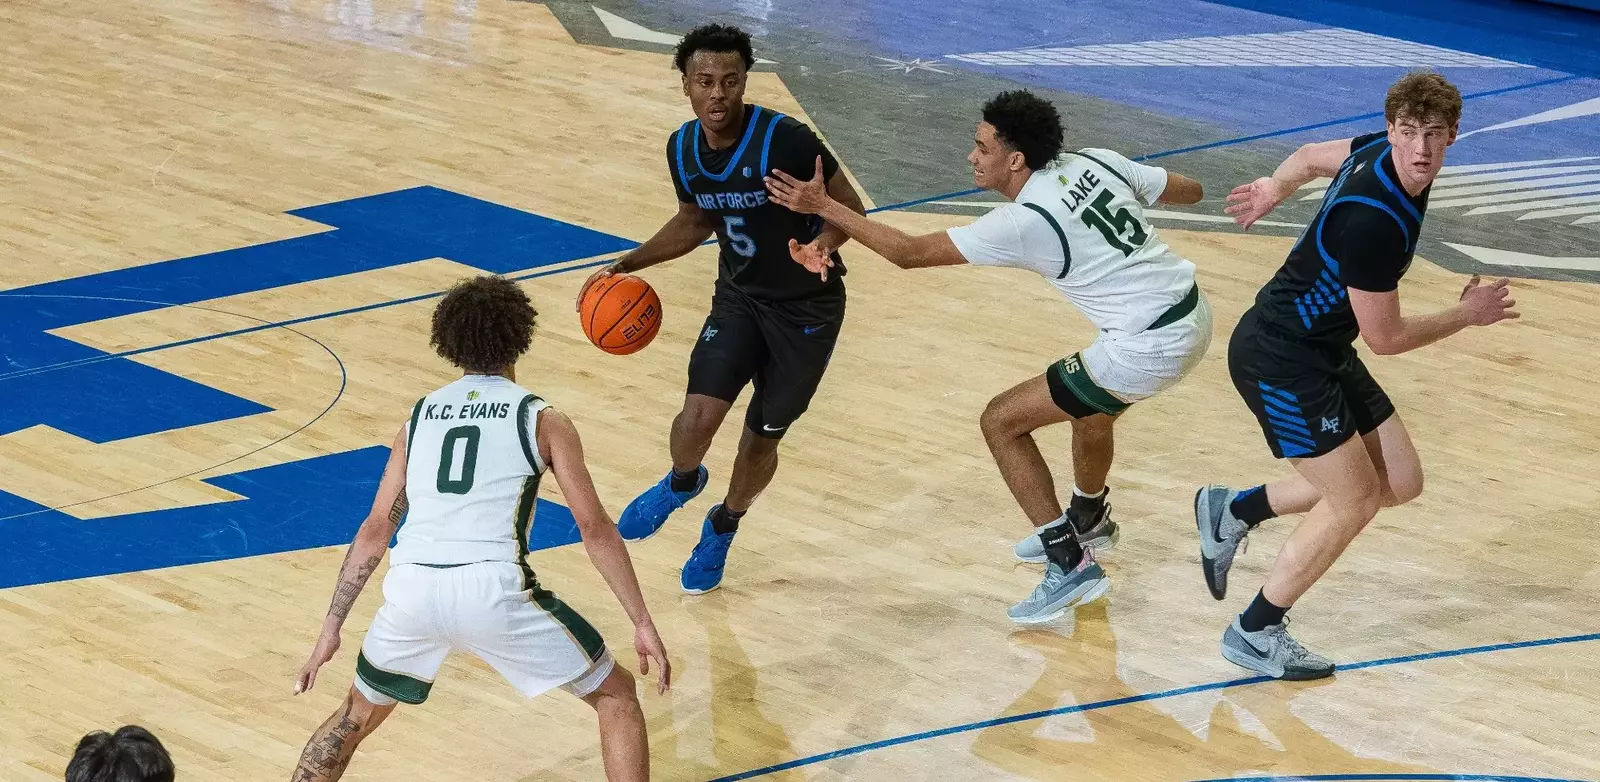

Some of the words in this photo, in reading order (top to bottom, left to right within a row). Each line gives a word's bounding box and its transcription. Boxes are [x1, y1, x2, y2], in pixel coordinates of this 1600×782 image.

[695, 193, 718, 209] AIR
[715, 189, 768, 209] FORCE
[1061, 169, 1101, 213] LAKE
[723, 215, 757, 257] 5
[1081, 187, 1148, 258] 15
[425, 404, 454, 420] K.C.
[459, 402, 510, 419] EVANS
[1320, 416, 1339, 434] AF
[437, 425, 480, 495] 0
